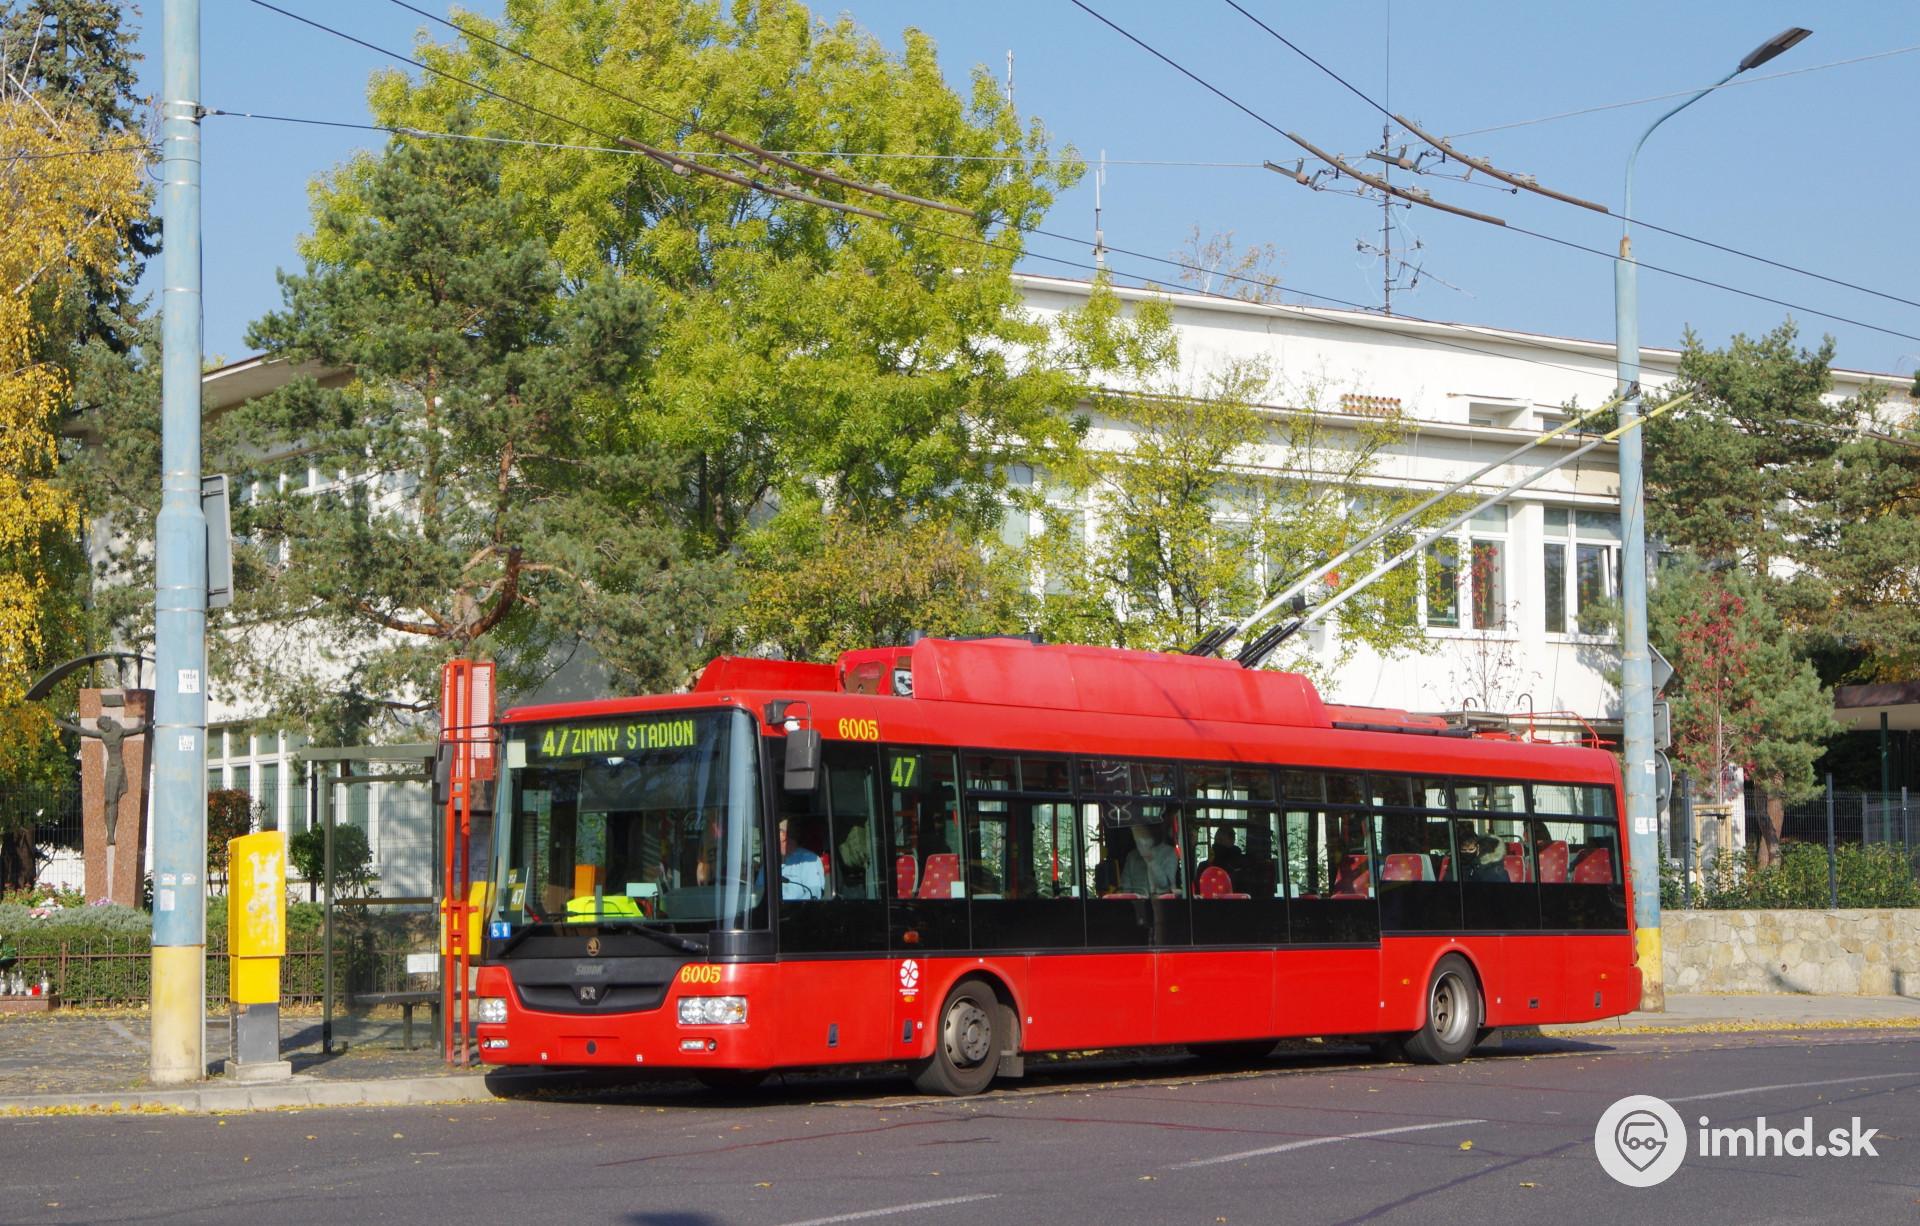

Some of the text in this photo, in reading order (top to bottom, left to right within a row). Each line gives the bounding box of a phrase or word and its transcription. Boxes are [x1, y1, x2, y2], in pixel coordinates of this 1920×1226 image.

[572, 726, 618, 753] ZIMNY
[627, 719, 693, 749] STADION
[838, 717, 879, 741] 6005
[890, 756, 916, 787] 47
[680, 965, 721, 984] 6005
